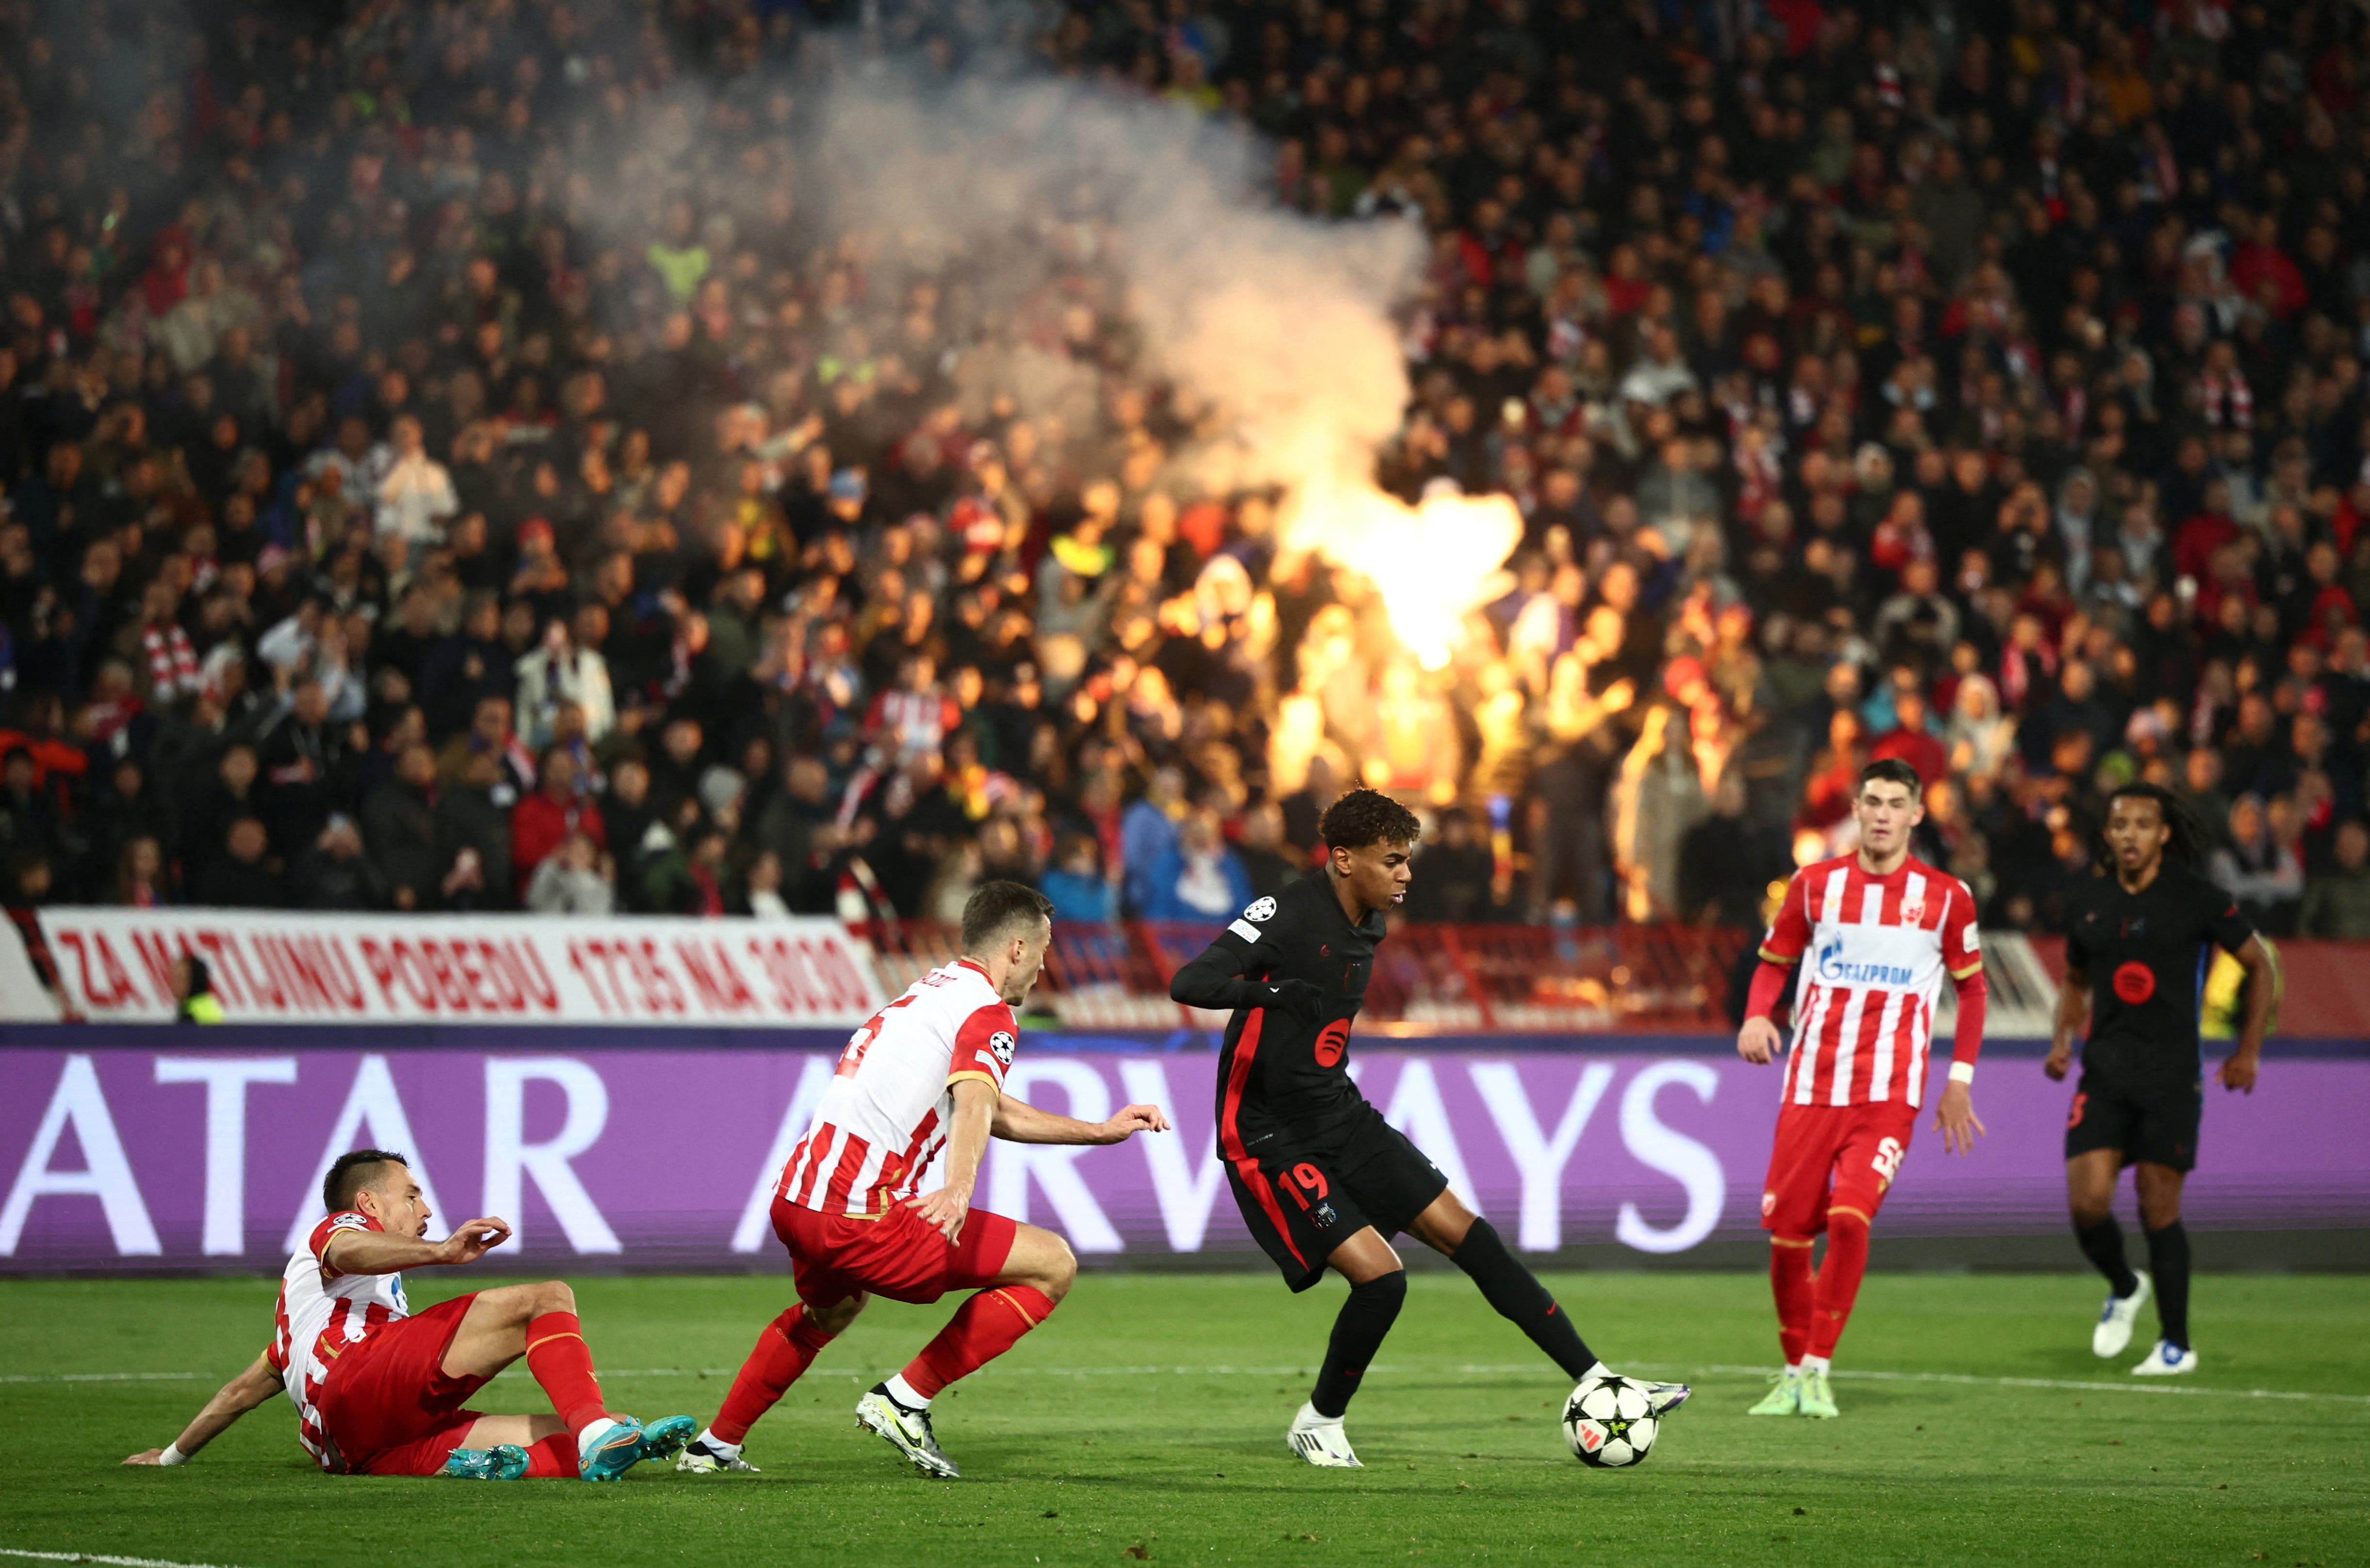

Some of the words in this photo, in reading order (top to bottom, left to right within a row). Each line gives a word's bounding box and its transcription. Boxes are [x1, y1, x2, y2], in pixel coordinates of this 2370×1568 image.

[57, 926, 147, 1010] ZA
[359, 935, 560, 1012] POBEDU
[674, 937, 763, 1014] NA
[1845, 963, 1913, 985] GAZPROM
[730, 1053, 1726, 1254] RAYS
[1278, 1163, 1330, 1212] 19
